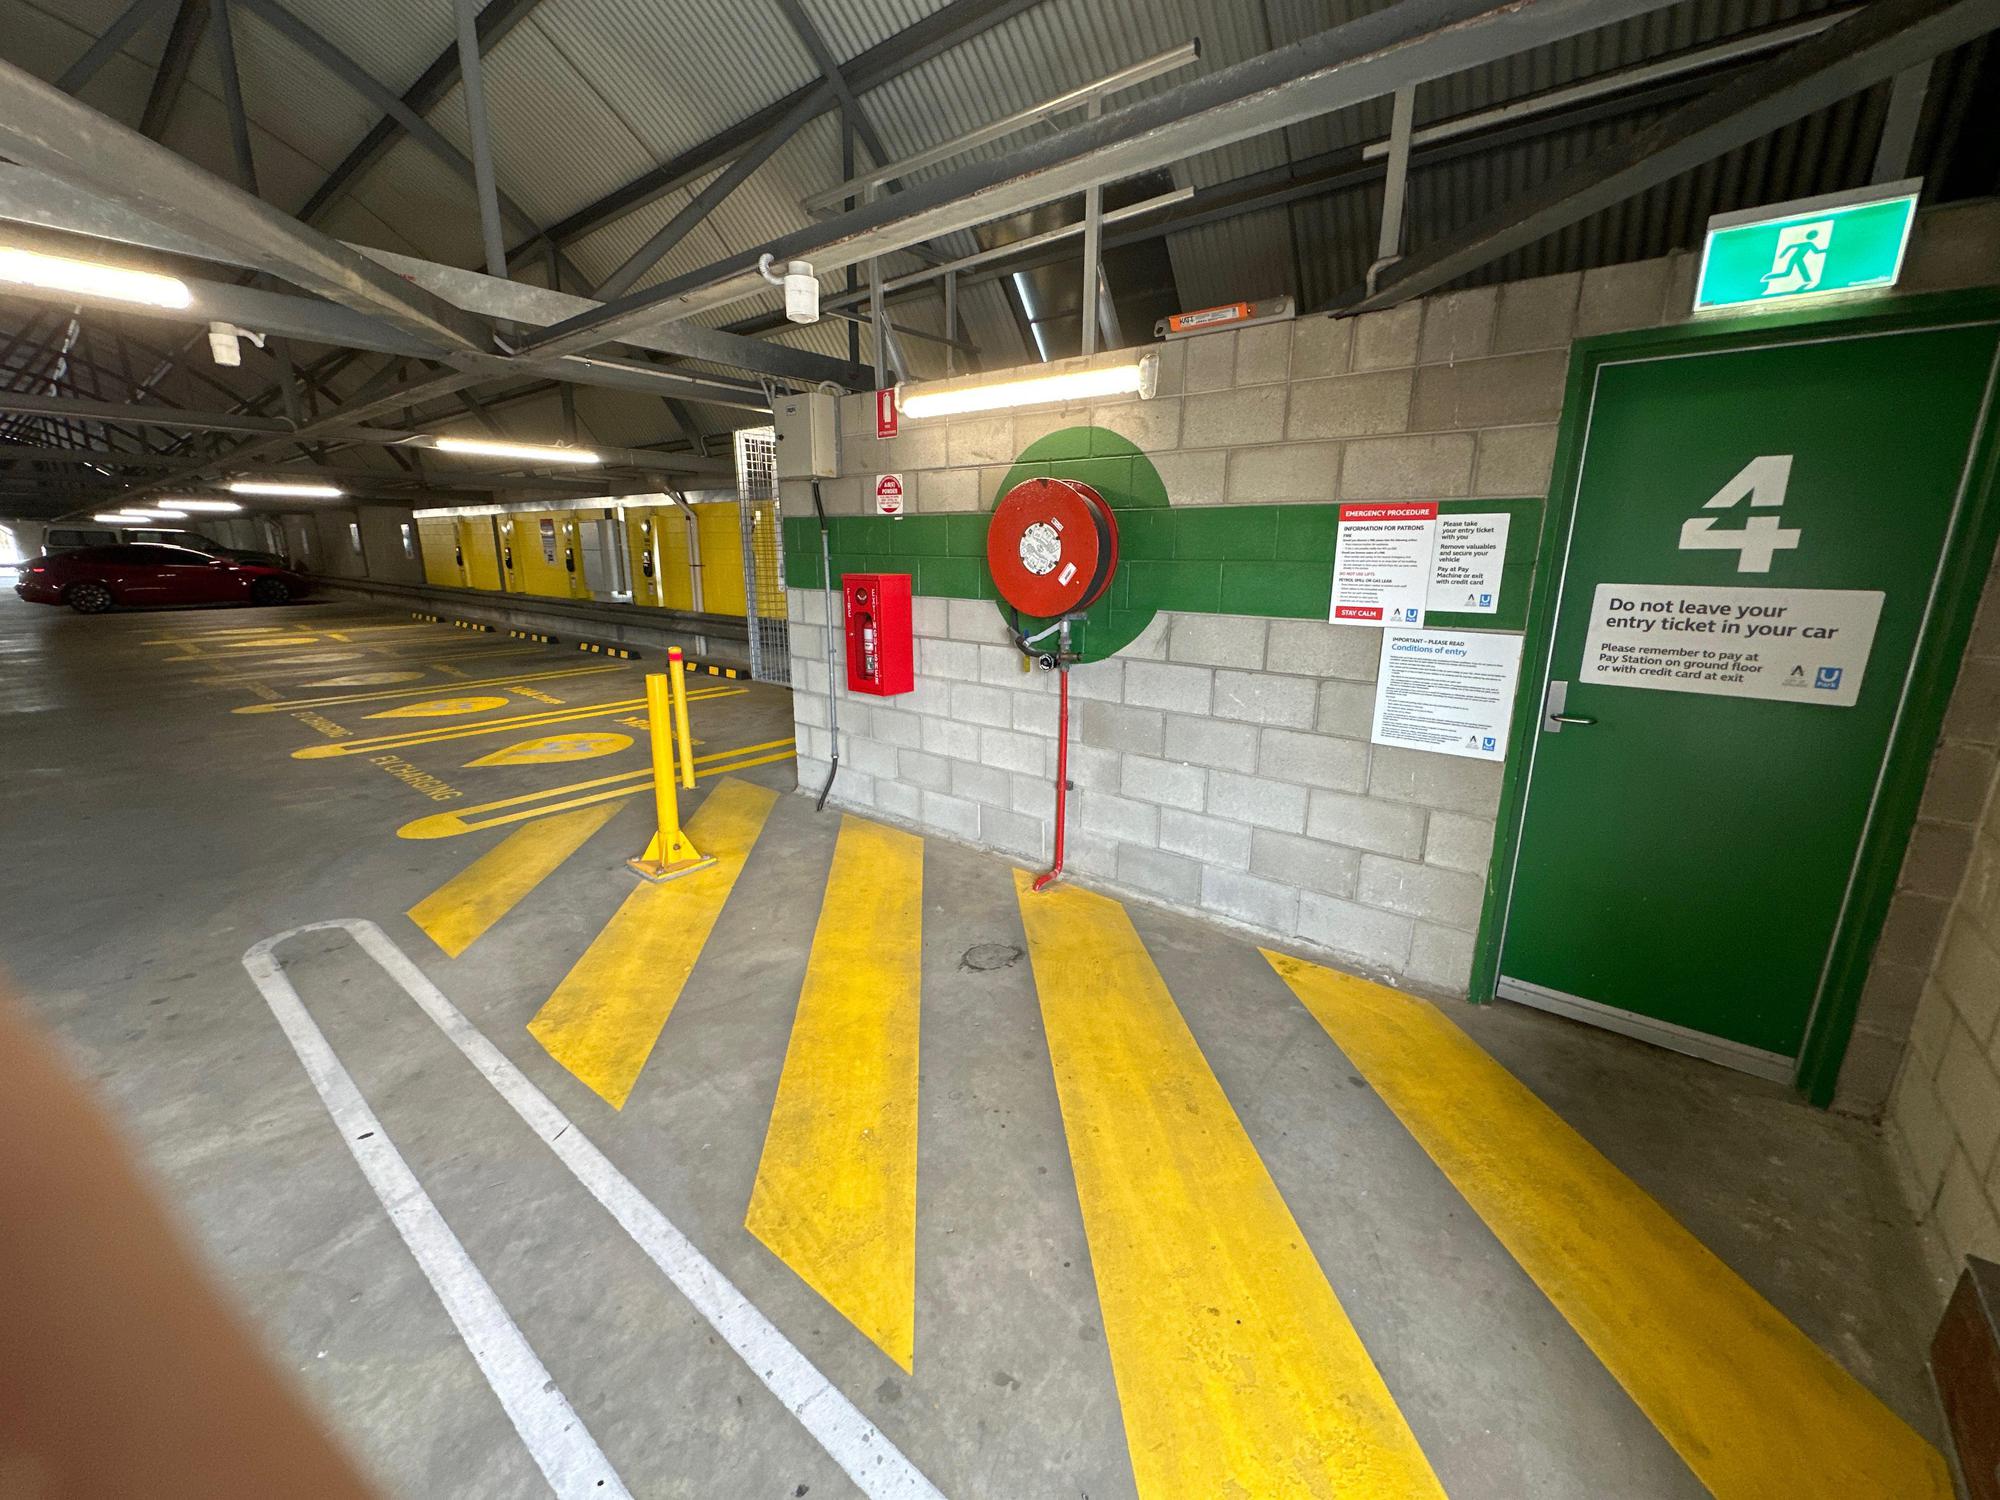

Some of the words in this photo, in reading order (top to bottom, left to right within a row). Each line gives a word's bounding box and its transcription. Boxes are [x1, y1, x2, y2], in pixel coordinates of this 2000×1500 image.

[1678, 454, 1802, 573] 4
[1609, 598, 1634, 612] Do
[1640, 600, 1674, 614] not
[1679, 600, 1731, 616] leave
[1736, 605, 1787, 619] your
[1606, 617, 1657, 632] entry
[1661, 618, 1716, 634] ticket
[1722, 621, 1740, 634] in
[1744, 623, 1797, 638] your
[1802, 627, 1838, 639] car
[1392, 644, 1433, 653] Conditions
[1445, 648, 1467, 657] entry
[1601, 643, 1635, 654] Please
[1638, 646, 1700, 658] remember
[1703, 649, 1715, 659] to
[1719, 652, 1742, 662] pay
[1745, 653, 1759, 662] at
[1599, 653, 1619, 664] Pay
[1622, 655, 1663, 666] Station
[1666, 659, 1680, 667] on
[1683, 659, 1728, 671] ground
[1732, 662, 1763, 673] floor
[1612, 663, 1636, 674] with
[1639, 666, 1672, 677] credit
[1675, 668, 1701, 679] card
[1704, 671, 1717, 680] at
[1720, 672, 1744, 683] exit
[384, 764, 464, 802] CHARGING
